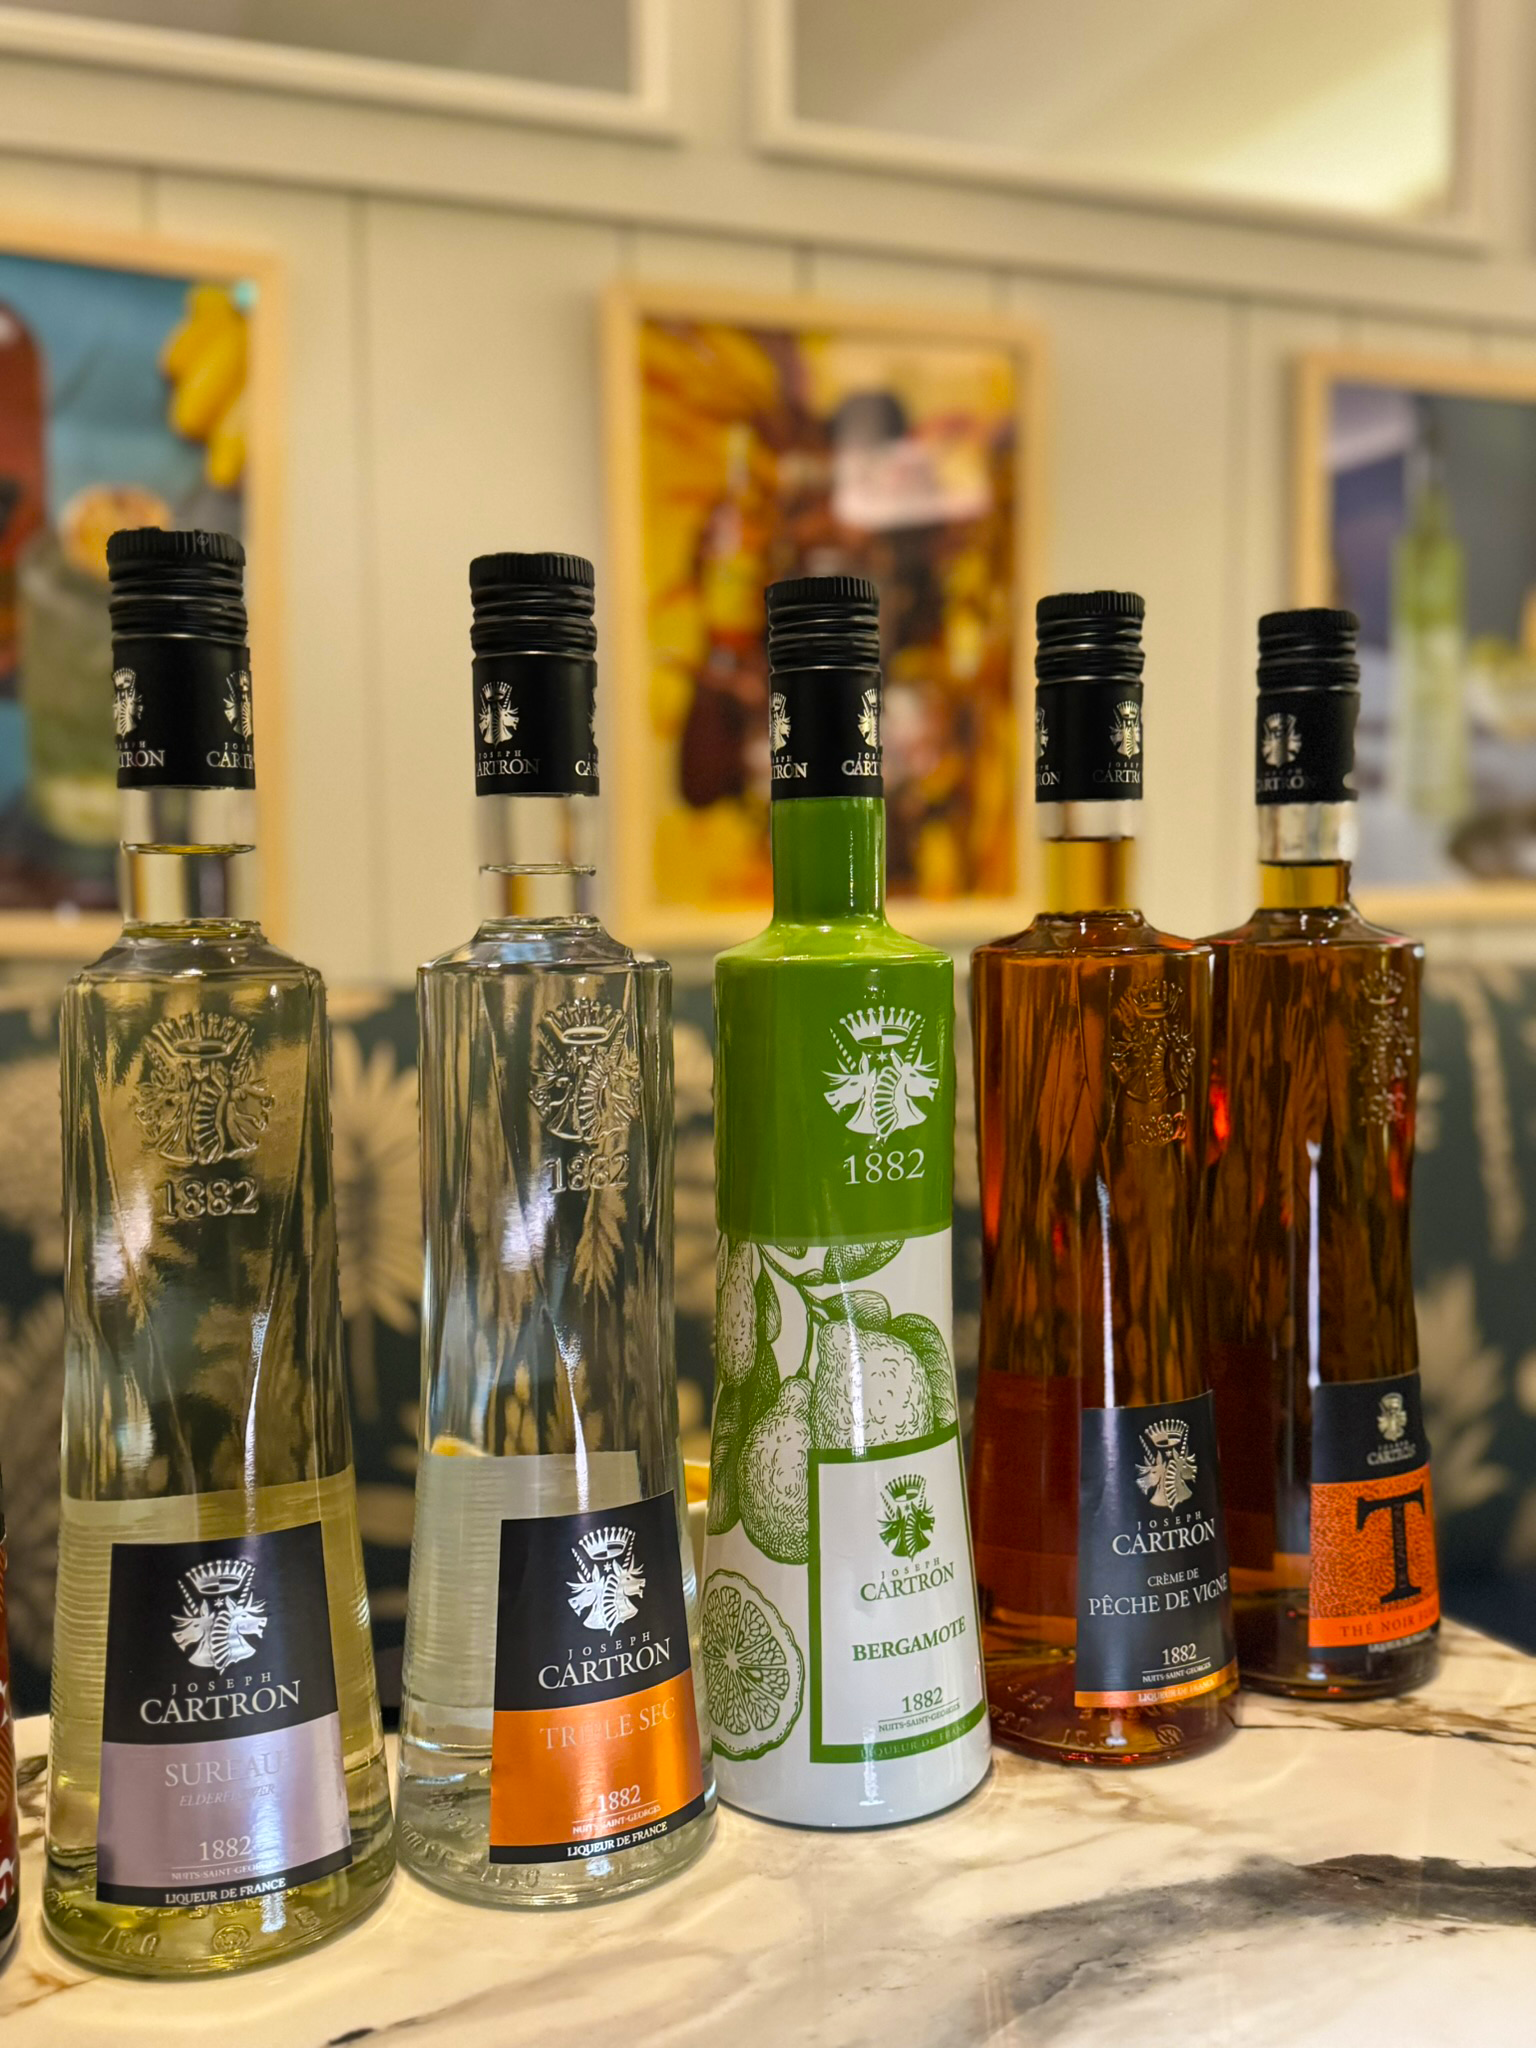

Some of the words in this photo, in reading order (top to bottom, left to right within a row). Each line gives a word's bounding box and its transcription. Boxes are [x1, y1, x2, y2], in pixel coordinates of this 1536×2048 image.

[119, 750, 165, 768] TRON
[477, 758, 541, 777] ARTRON
[773, 762, 808, 780] TRON
[841, 760, 880, 776] CART
[547, 1151, 631, 1193] 1882
[845, 1149, 926, 1185] 1882
[155, 1175, 260, 1222] 1882
[1137, 1510, 1202, 1531] JOSEPH
[1112, 1518, 1216, 1556] CARTRON
[1356, 1483, 1426, 1605] T
[860, 1561, 955, 1602] CARTRON
[881, 1557, 941, 1580] JOSEPH
[1147, 1572, 1186, 1587] CRÈME
[1186, 1567, 1199, 1581] DE
[1088, 1594, 1161, 1616] PÊCHE
[1165, 1589, 1191, 1611] DE
[1192, 1573, 1228, 1604] VIGNE
[568, 1631, 650, 1660] JOSEPH
[852, 1615, 967, 1662] BERGAMOTE
[538, 1637, 671, 1690] CARTRON
[1162, 1643, 1197, 1666] 1882
[171, 1671, 272, 1696] JOSEPH
[139, 1679, 301, 1725] CARTRON
[639, 1697, 676, 1731] SEC
[902, 1686, 944, 1714] 1882
[861, 1741, 917, 1758] LQUEUR
[164, 1750, 283, 1787] SUREAU
[178, 1783, 276, 1807] ELDERFLER
[598, 1784, 641, 1815] 1882
[199, 1835, 253, 1861] 1882
[567, 1839, 615, 1857] LIQUEUR
[616, 1835, 632, 1848] DE
[632, 1821, 668, 1843] FRANCE
[165, 1890, 218, 1906] LIQUEUR
[220, 1887, 238, 1900] DE
[240, 1877, 287, 1897] FRANCE
